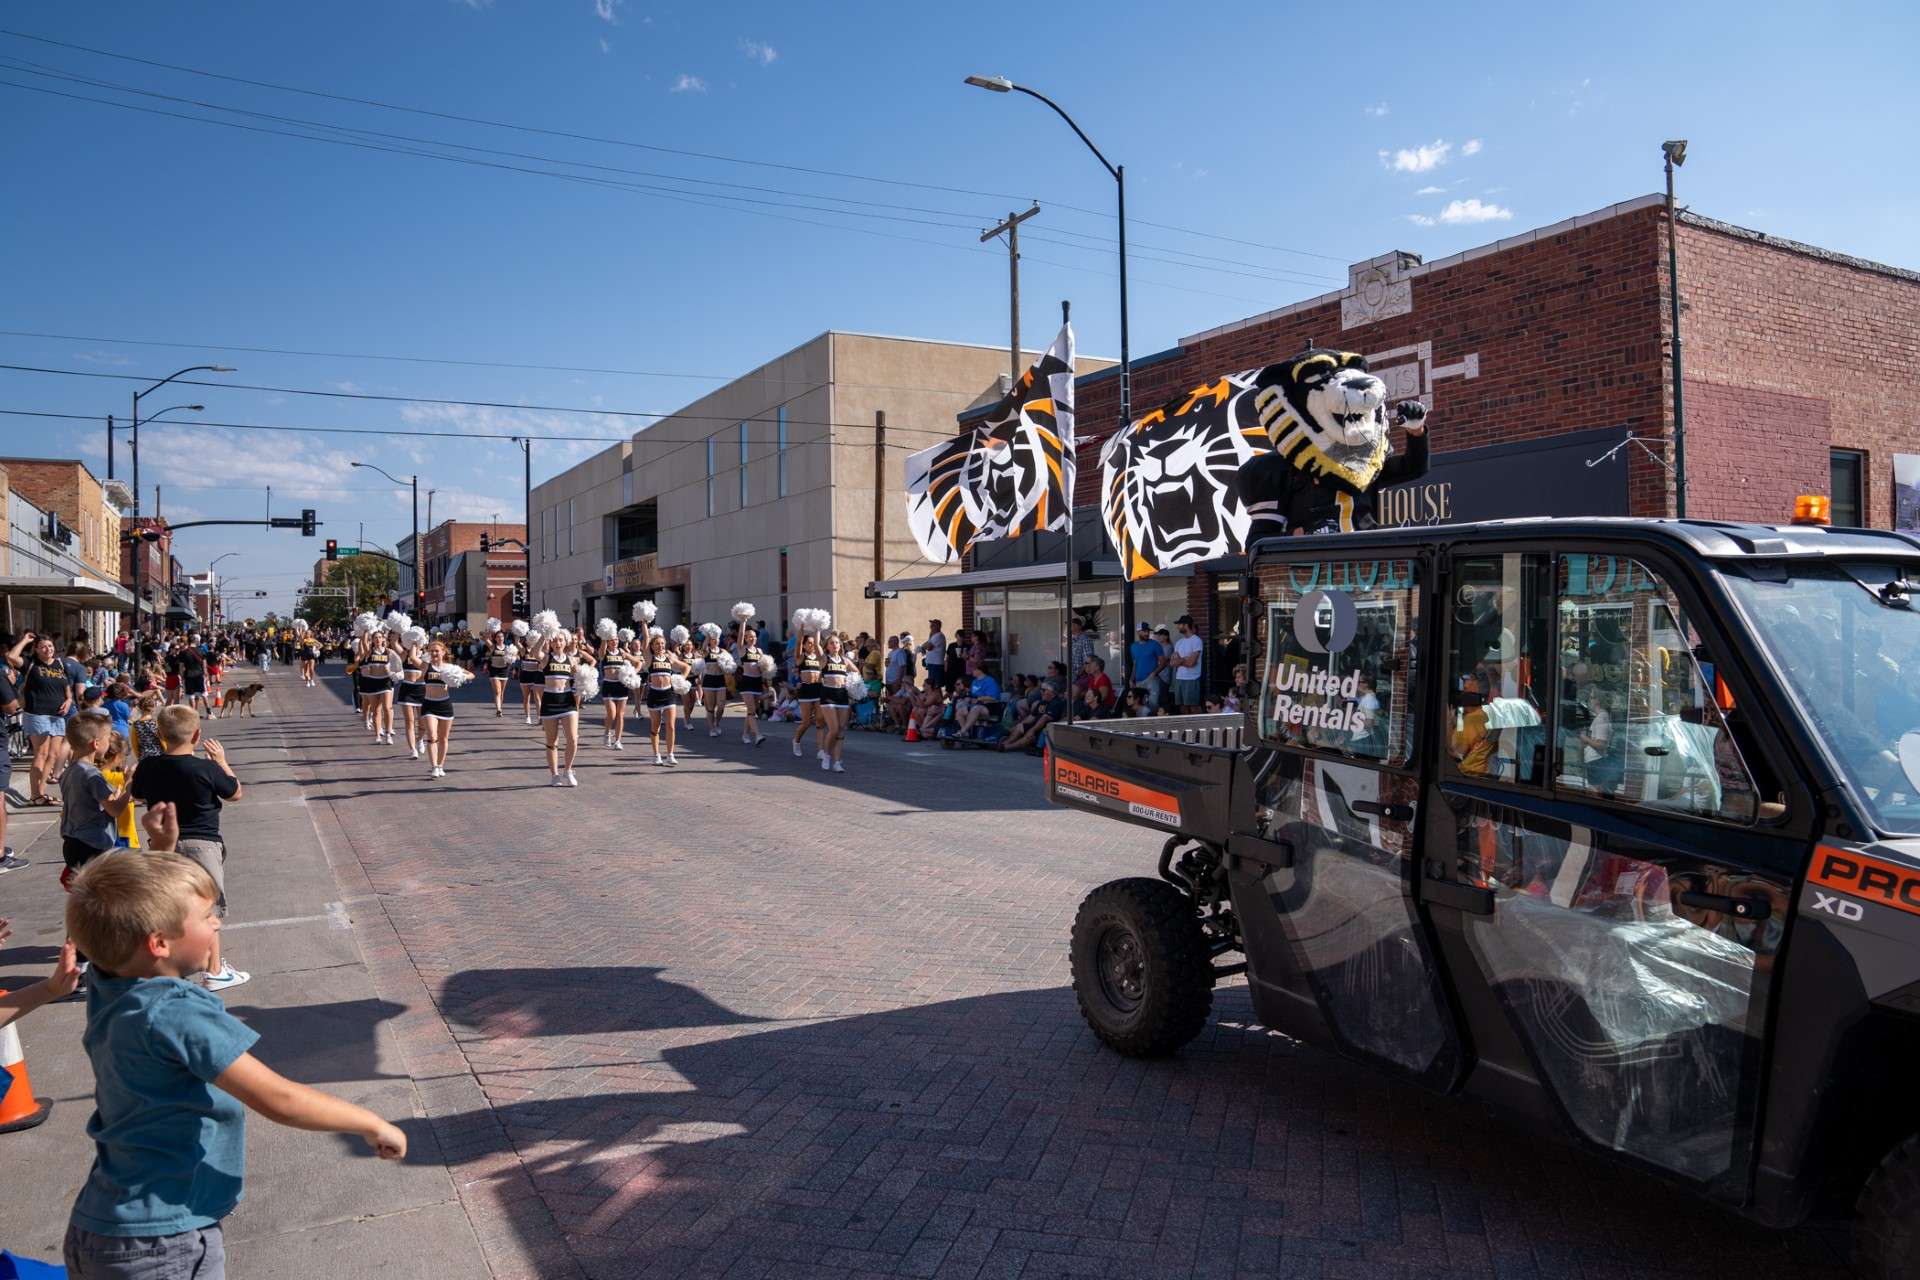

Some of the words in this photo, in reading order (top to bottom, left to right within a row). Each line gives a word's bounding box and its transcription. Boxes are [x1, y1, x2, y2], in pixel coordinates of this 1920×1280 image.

[1378, 482, 1452, 526] HOUSE
[549, 663, 571, 673] TIGERS
[1275, 662, 1360, 698] United
[1272, 694, 1366, 732] Rentals
[1057, 768, 1120, 795] POLARIS
[1811, 891, 1864, 922] XD
